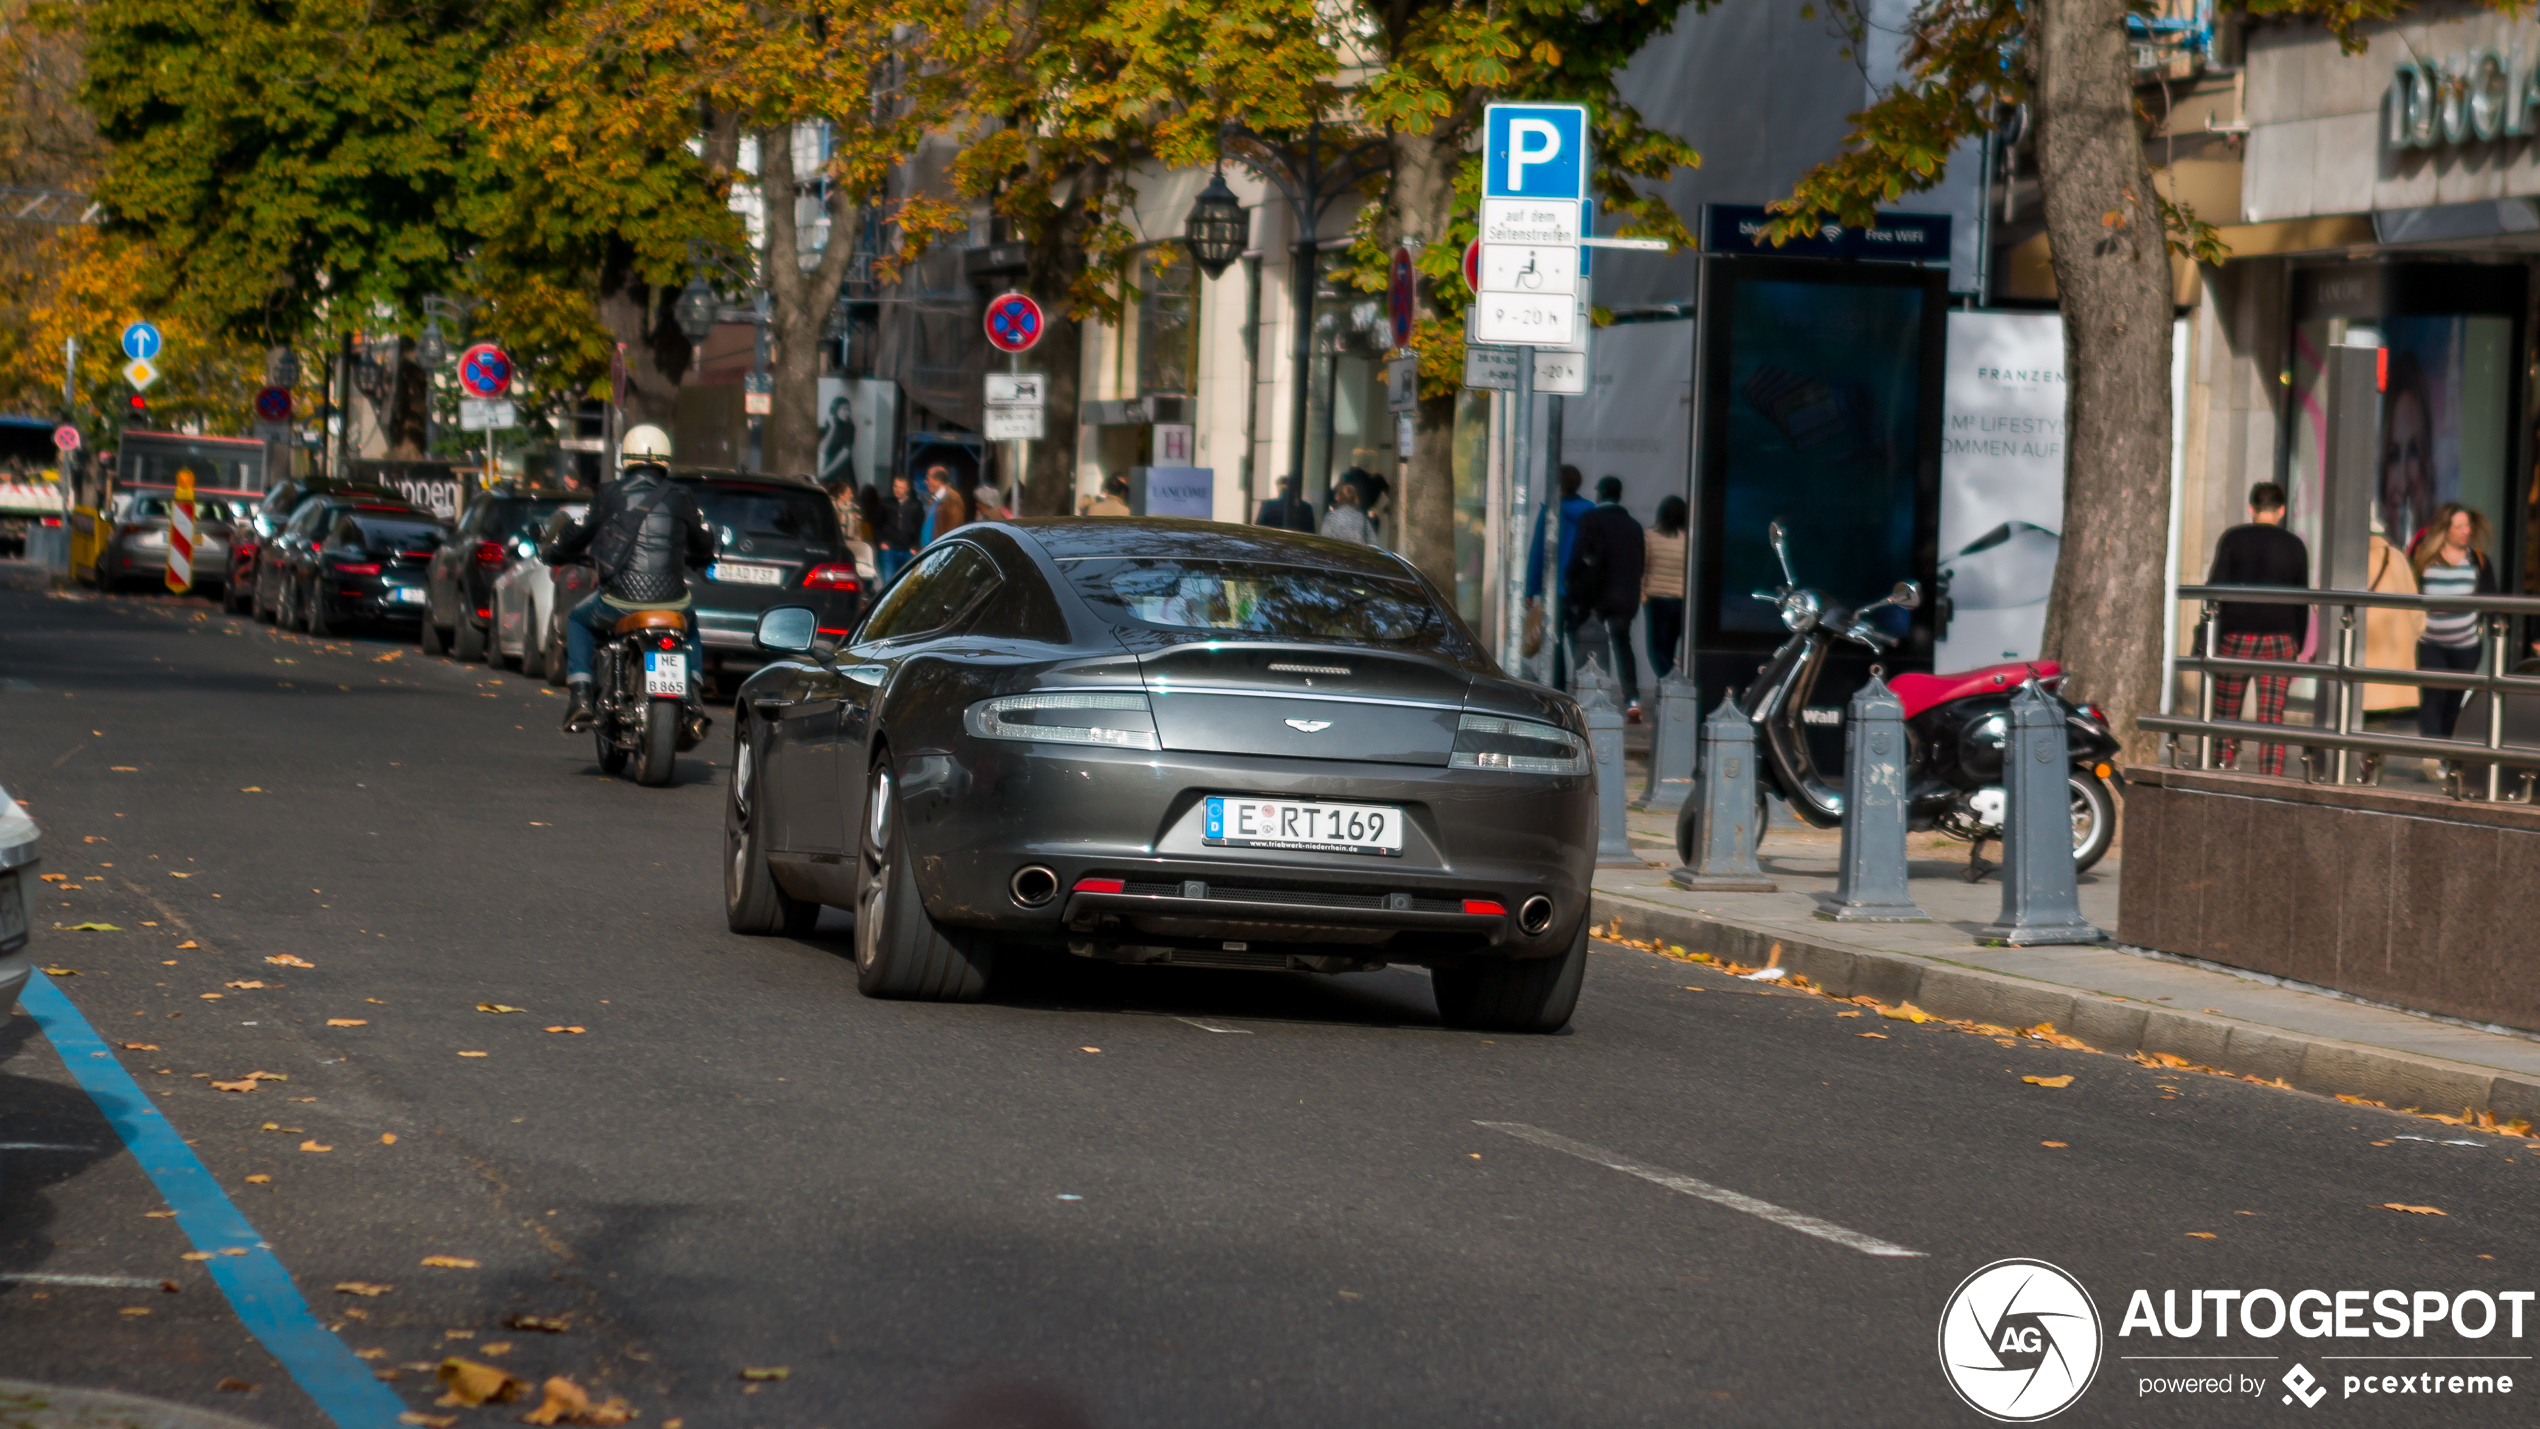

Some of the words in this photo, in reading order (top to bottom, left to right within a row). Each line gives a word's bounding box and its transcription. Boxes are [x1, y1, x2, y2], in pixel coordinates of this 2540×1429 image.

[1508, 118, 1561, 191] P
[1506, 208, 1524, 222] auf
[1531, 209, 1555, 222] dem
[1489, 225, 1571, 242] Seitenstreifen
[1865, 229, 1892, 241] Free
[1548, 310, 1558, 325] h
[1978, 367, 2065, 383] FRANZEN
[2022, 441, 2060, 458] AUF
[661, 655, 677, 667] ME
[1802, 709, 1839, 724] Wall
[1211, 821, 1220, 832] D
[1250, 840, 1358, 853] www.triebwerk-niederrhein.de
